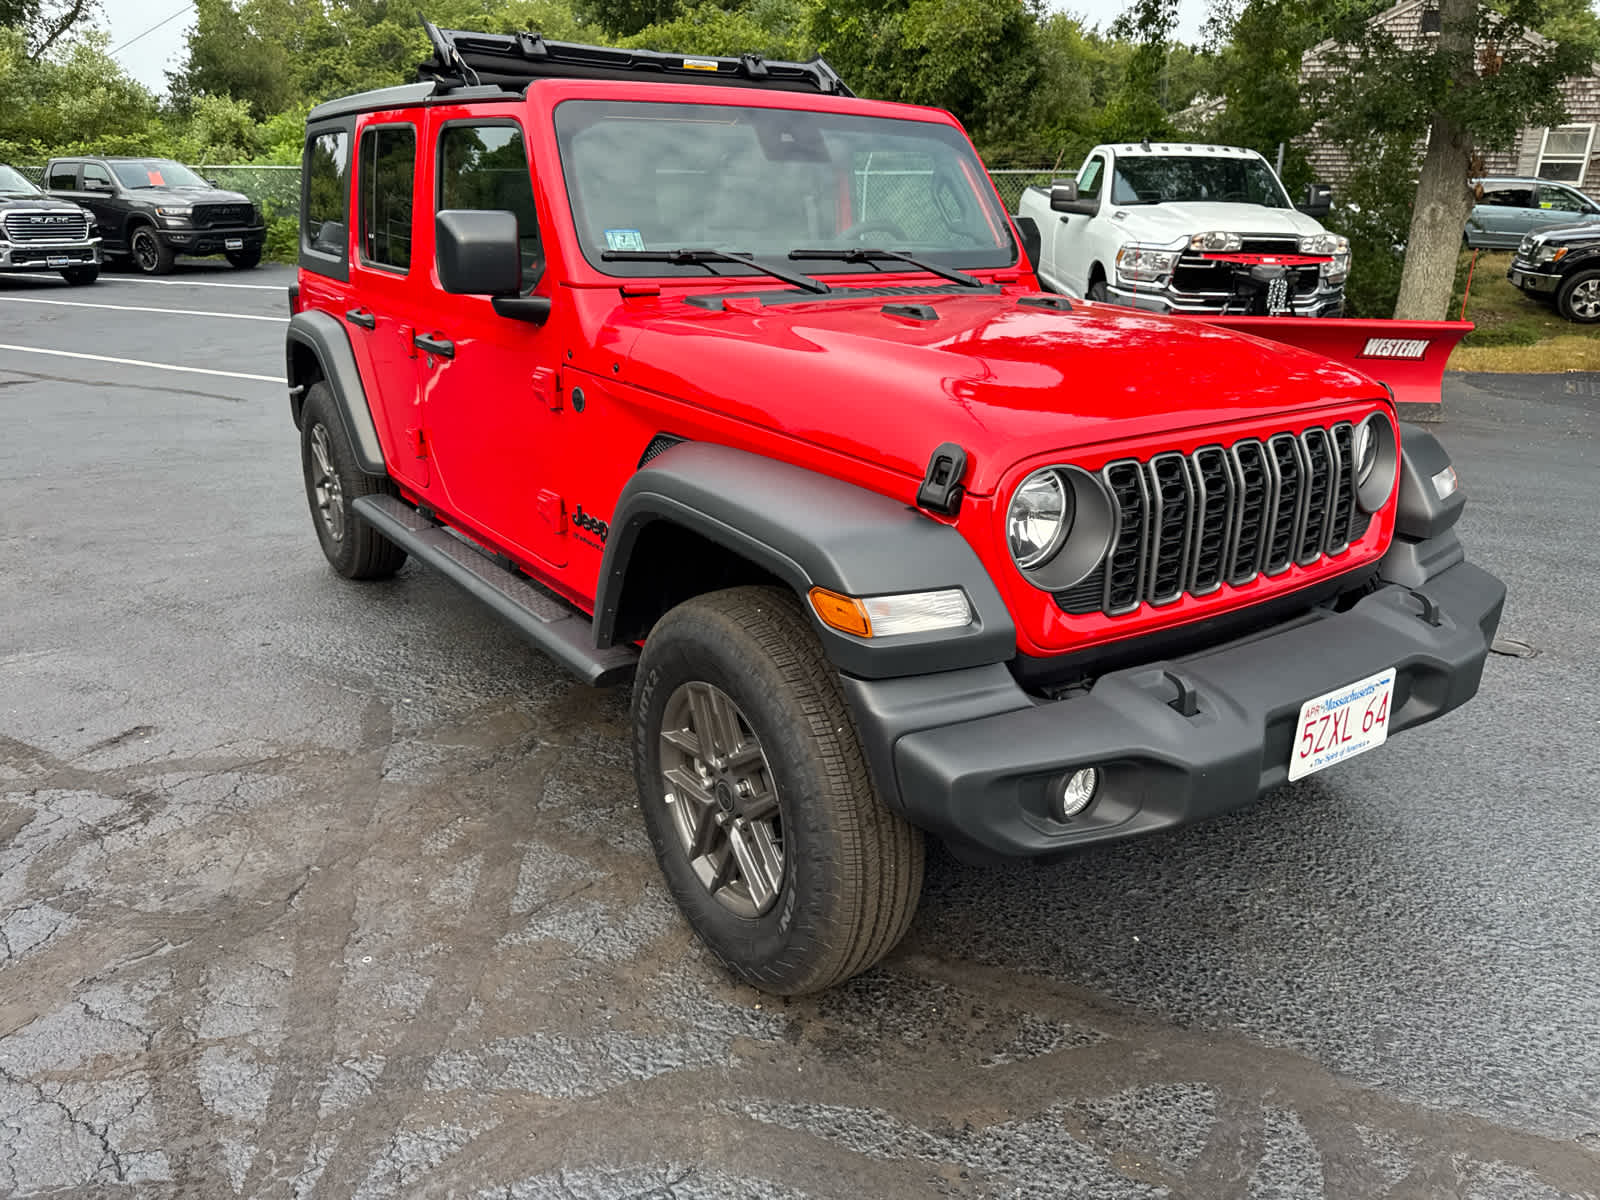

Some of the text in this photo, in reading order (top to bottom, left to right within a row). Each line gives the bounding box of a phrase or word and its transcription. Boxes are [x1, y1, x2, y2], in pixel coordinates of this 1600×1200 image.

[1363, 338, 1430, 358] WESTERN
[571, 503, 608, 543] Jeep
[1325, 685, 1375, 711] Massachusetts
[1305, 704, 1321, 719] APR
[1300, 691, 1388, 759] 5ZXL 64
[1314, 756, 1325, 766] The
[1346, 741, 1366, 753] America
